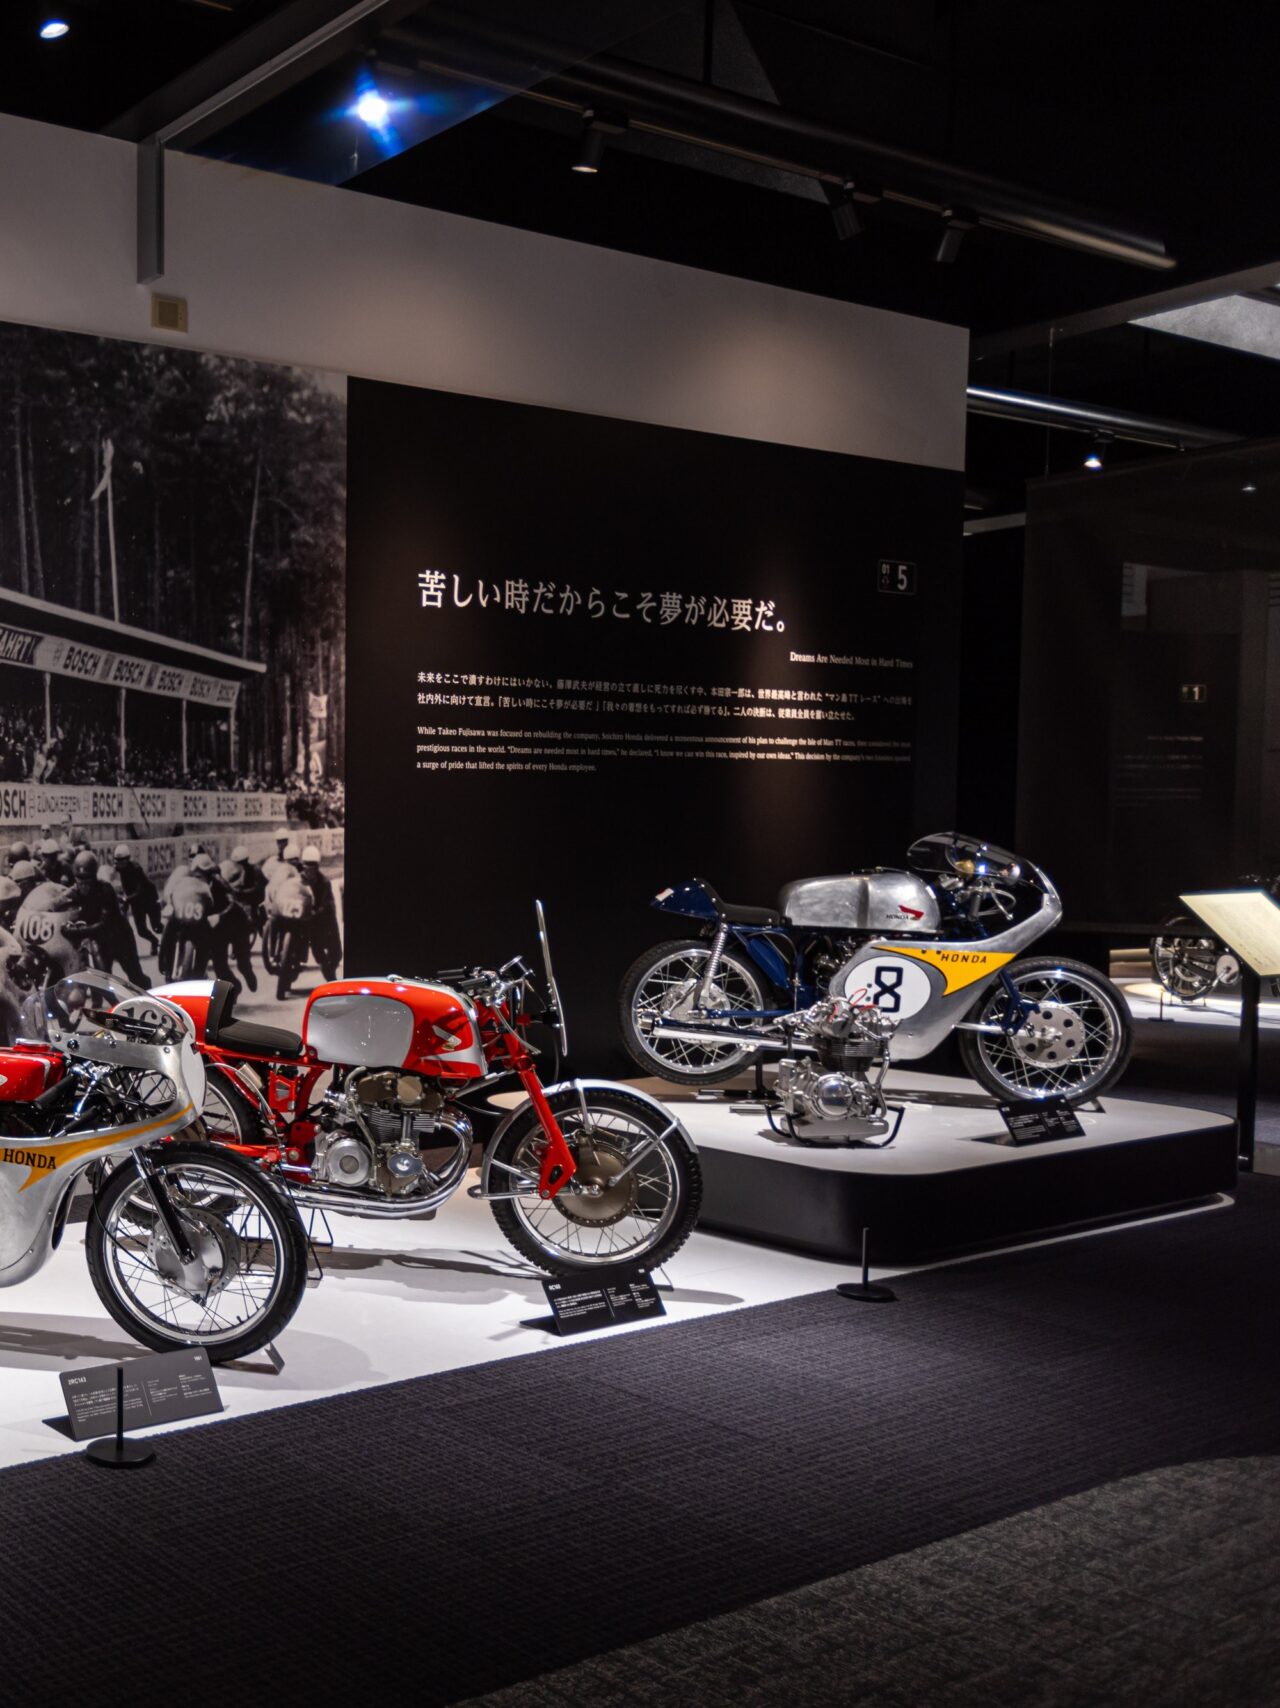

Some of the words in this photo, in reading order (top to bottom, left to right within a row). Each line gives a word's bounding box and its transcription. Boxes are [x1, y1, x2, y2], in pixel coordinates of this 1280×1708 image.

[897, 565, 907, 591] 5
[417, 570, 786, 633] 苦しい時だからこそ夢が必要だ。
[62, 645, 101, 676] BOSCH
[790, 651, 815, 663] Dreams
[816, 654, 828, 664] Are
[829, 655, 853, 665] Needed
[855, 657, 869, 666] Most
[112, 659, 147, 686] BOSCH
[157, 670, 185, 694] BOSCH
[417, 727, 436, 735] While
[458, 728, 485, 738] Fujisawa
[500, 729, 522, 737] focused
[563, 731, 572, 739] the
[757, 737, 767, 745] plan
[417, 744, 450, 753] prestigious
[476, 745, 486, 753] the
[487, 745, 506, 753] world.
[422, 762, 439, 770] surge
[448, 761, 464, 771] pride
[465, 761, 477, 769] that
[478, 761, 494, 770] lifted
[495, 762, 505, 770] the
[506, 762, 523, 771] spirits
[92, 791, 124, 818] BOSCH
[140, 793, 166, 818] BOSCH
[183, 795, 207, 817] BOSCH
[21, 916, 53, 941] 108
[940, 953, 988, 964] HONDA
[873, 966, 903, 1013] 8
[2, 1147, 57, 1170] HONDA
